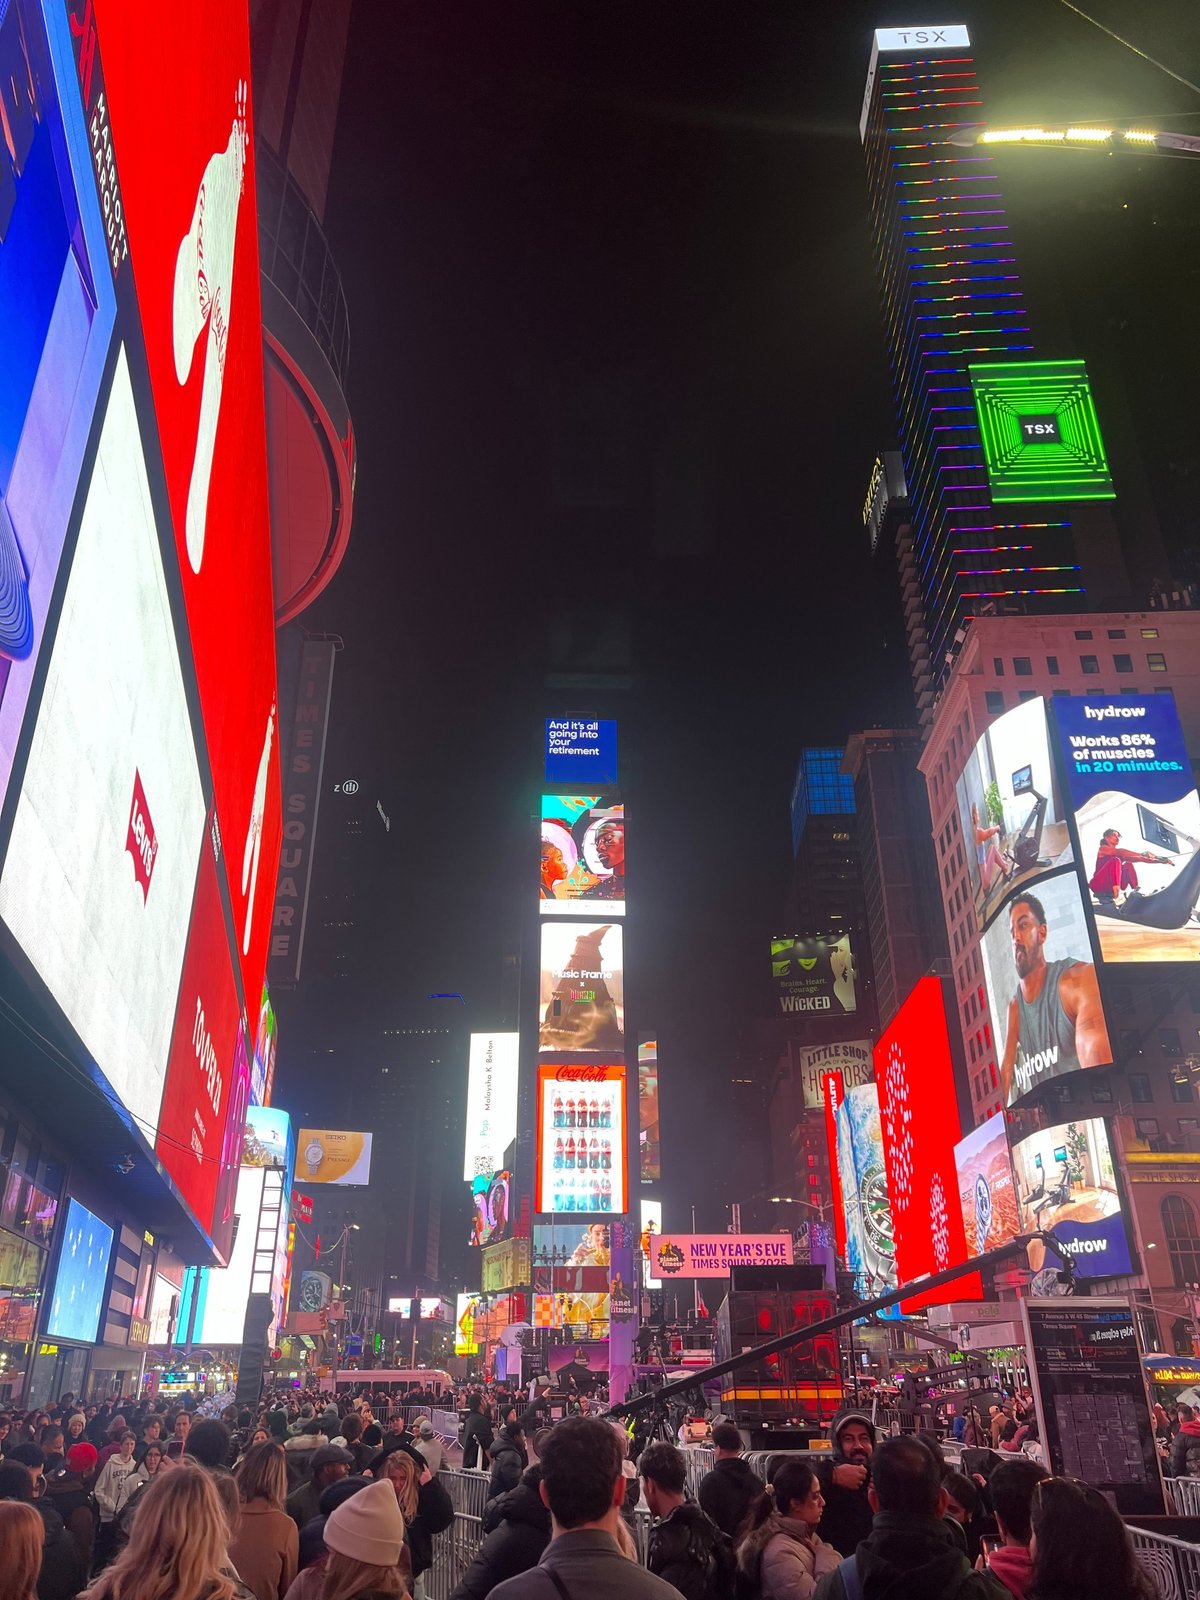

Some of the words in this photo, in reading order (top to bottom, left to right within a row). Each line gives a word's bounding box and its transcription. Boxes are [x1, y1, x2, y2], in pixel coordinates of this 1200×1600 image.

[898, 31, 946, 44] TSX
[97, 92, 128, 261] MARRIOTT
[91, 116, 120, 268] MARQUIS
[1024, 424, 1055, 434] TSX
[293, 655, 320, 774] TIMES
[1084, 705, 1146, 721] hydrow
[549, 721, 569, 729] And
[571, 721, 584, 730] it's
[586, 722, 598, 730] all
[549, 730, 577, 739] going
[579, 730, 598, 738] into
[1069, 735, 1120, 747] Works
[1121, 734, 1156, 746] 86%
[549, 738, 571, 747] your
[549, 746, 599, 755] retirement
[1073, 748, 1089, 760] of
[1091, 747, 1155, 759] muscles
[1075, 761, 1091, 773] in
[1093, 761, 1113, 772] 20
[1116, 760, 1183, 771] minutes.
[271, 793, 306, 957] SQUARE
[552, 969, 579, 979] Music
[580, 970, 612, 979] Frame
[805, 978, 828, 986] Heart.
[789, 985, 820, 993] Courage.
[192, 995, 217, 1102] TOWER
[808, 1045, 840, 1067] LITTLE
[842, 1045, 868, 1061] SHOP
[556, 1065, 608, 1082] Coca-Cola
[1014, 1045, 1058, 1090] hydrow
[808, 1064, 869, 1100] HOORS
[690, 1243, 717, 1256] NEW
[719, 1243, 763, 1256] YEAR'S
[765, 1243, 786, 1256] EVE
[691, 1259, 719, 1268] TIMES
